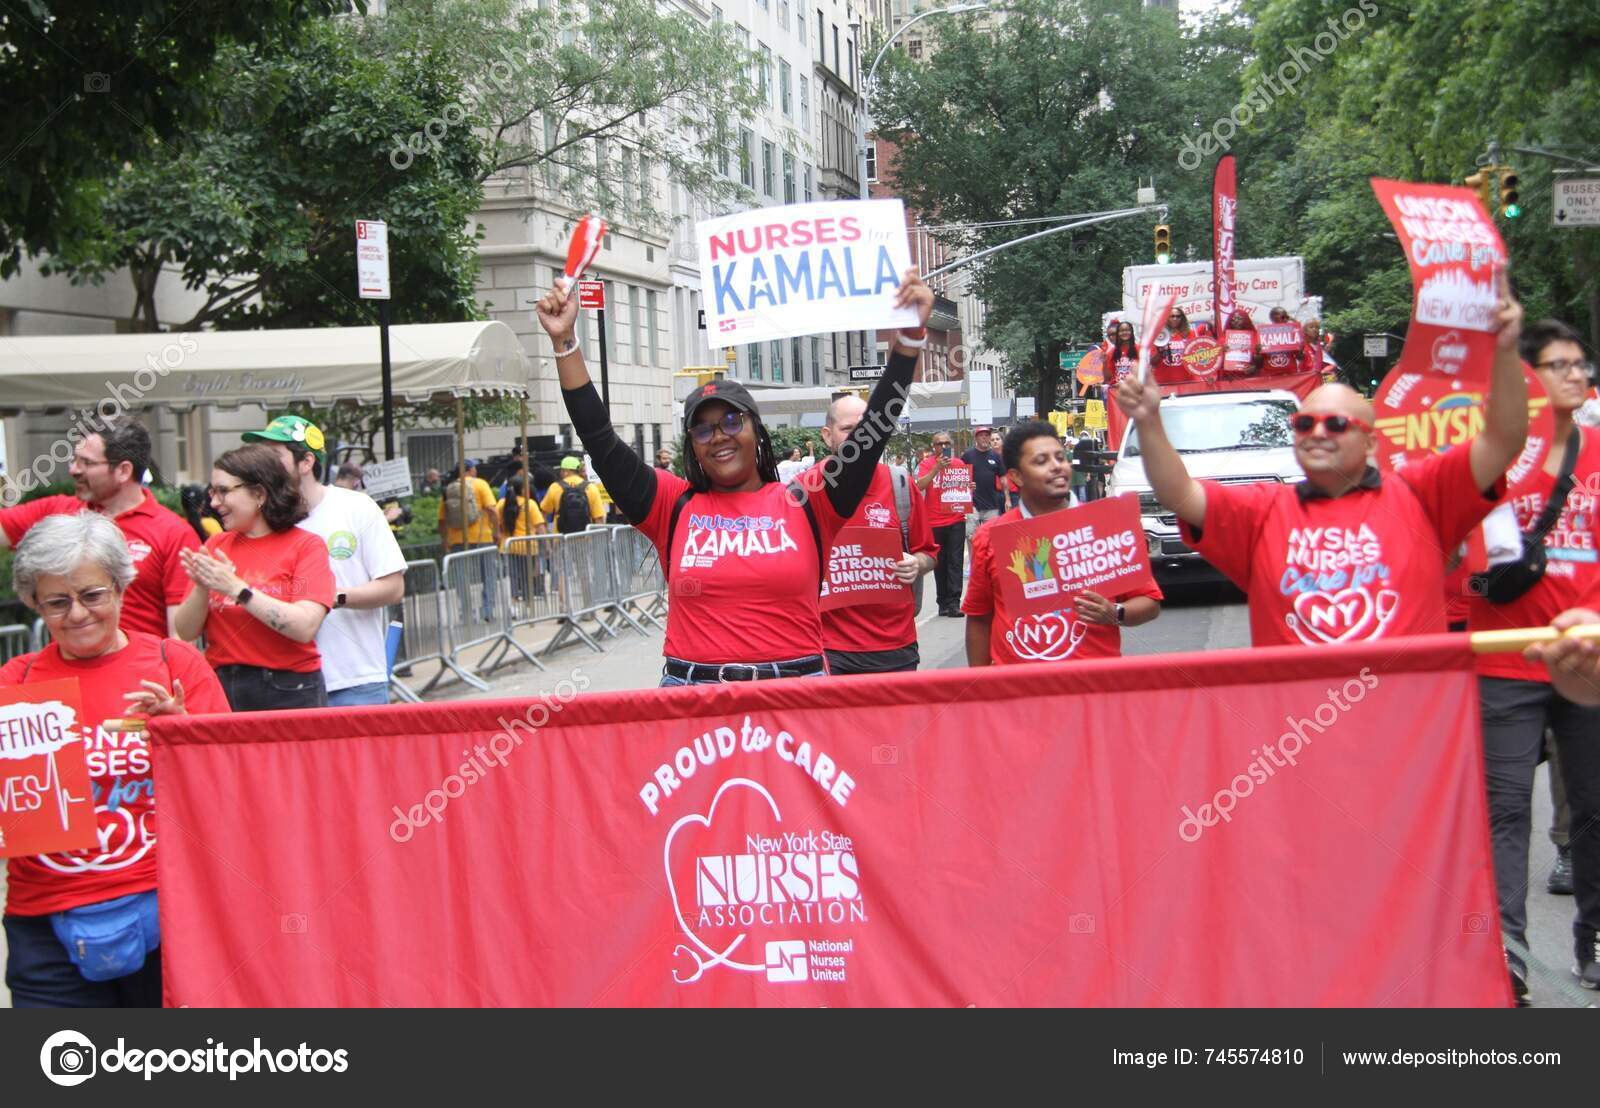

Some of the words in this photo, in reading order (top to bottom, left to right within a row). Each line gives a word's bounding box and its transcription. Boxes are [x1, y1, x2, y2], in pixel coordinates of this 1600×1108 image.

[1394, 195, 1480, 222] UNION
[1567, 196, 1596, 206] ONLY
[709, 217, 862, 261] NURSES
[1400, 216, 1496, 246] NURSES
[712, 245, 900, 315] KAMALA
[1252, 279, 1278, 290] Care
[1419, 298, 1452, 321] NEW
[1260, 332, 1300, 345] KAMALA
[689, 514, 774, 532] NURSES
[683, 525, 798, 556] KAMALA
[1053, 526, 1094, 549] ONE
[1056, 530, 1135, 565] STRONG
[829, 557, 897, 571] STRONG
[1059, 551, 1122, 581] UNION
[1286, 542, 1380, 570] NURSES
[830, 569, 885, 584] UNION
[851, 583, 880, 591] United
[1062, 582, 1083, 591] One
[1085, 570, 1116, 587] United
[1117, 563, 1142, 576] Voice
[1280, 566, 1348, 595] Care
[1311, 599, 1358, 628] NY
[1023, 624, 1058, 643] NY
[640, 726, 736, 815] PROUD
[741, 715, 772, 752] to
[776, 731, 856, 807] CARE
[746, 834, 782, 853] New
[784, 830, 818, 851] York
[821, 830, 853, 851] State
[697, 850, 861, 906] NURSES
[809, 939, 853, 952] National
[811, 954, 845, 967] Nurses
[811, 969, 846, 981] United
